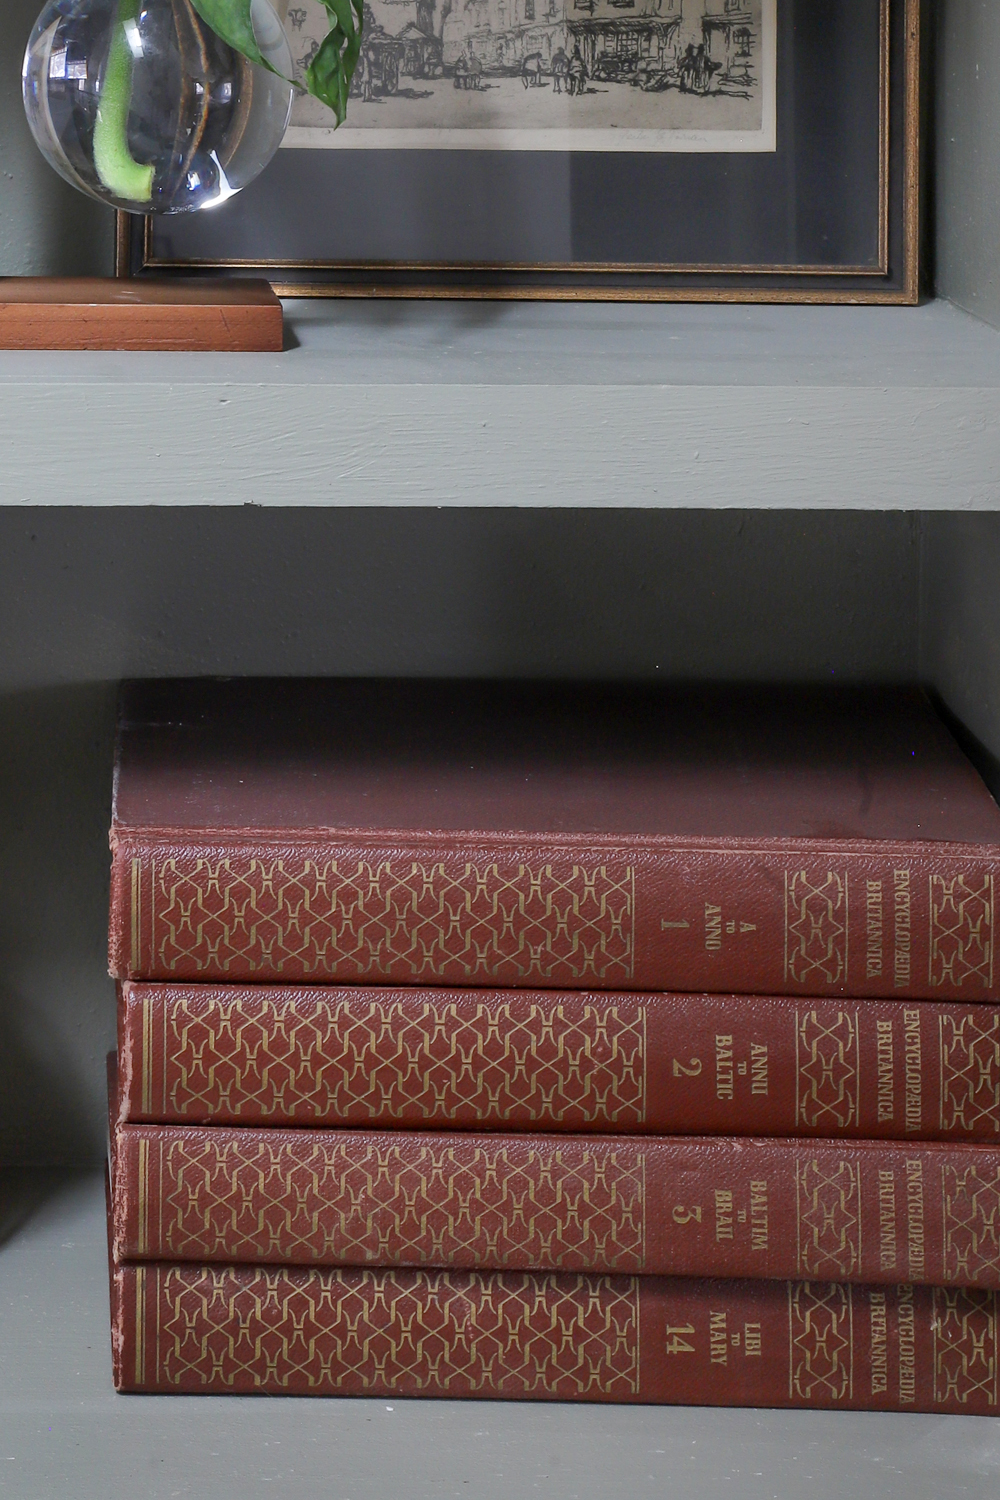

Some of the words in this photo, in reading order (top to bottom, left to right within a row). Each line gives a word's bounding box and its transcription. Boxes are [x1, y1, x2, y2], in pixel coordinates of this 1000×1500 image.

[661, 918, 690, 931] 1
[704, 902, 722, 951] ANNO
[725, 919, 735, 934] TO
[739, 920, 757, 933] A
[866, 879, 883, 979] BRITANNICA
[894, 869, 911, 989] ENCYCLOPÆDIA
[672, 1057, 702, 1078] 2
[715, 1034, 734, 1100] BALTIC
[737, 1060, 747, 1076] TO
[750, 1042, 769, 1096] ANNU
[876, 1020, 894, 1123] BRITANNICA
[903, 1008, 923, 1133] ENCYCLOPÆDIA
[672, 1204, 702, 1225] 3
[714, 1188, 734, 1243] BRAIL
[737, 1208, 747, 1223] TO
[750, 1180, 769, 1251] BALTIM
[878, 1169, 896, 1273] BRITANNICA
[906, 1158, 925, 1282] ENCYCLOPÆDIA
[666, 1322, 696, 1355] 14
[709, 1310, 727, 1367] MARY
[731, 1332, 741, 1346] TO
[744, 1322, 762, 1356] LIBI
[869, 1292, 888, 1396] BRITANNICA
